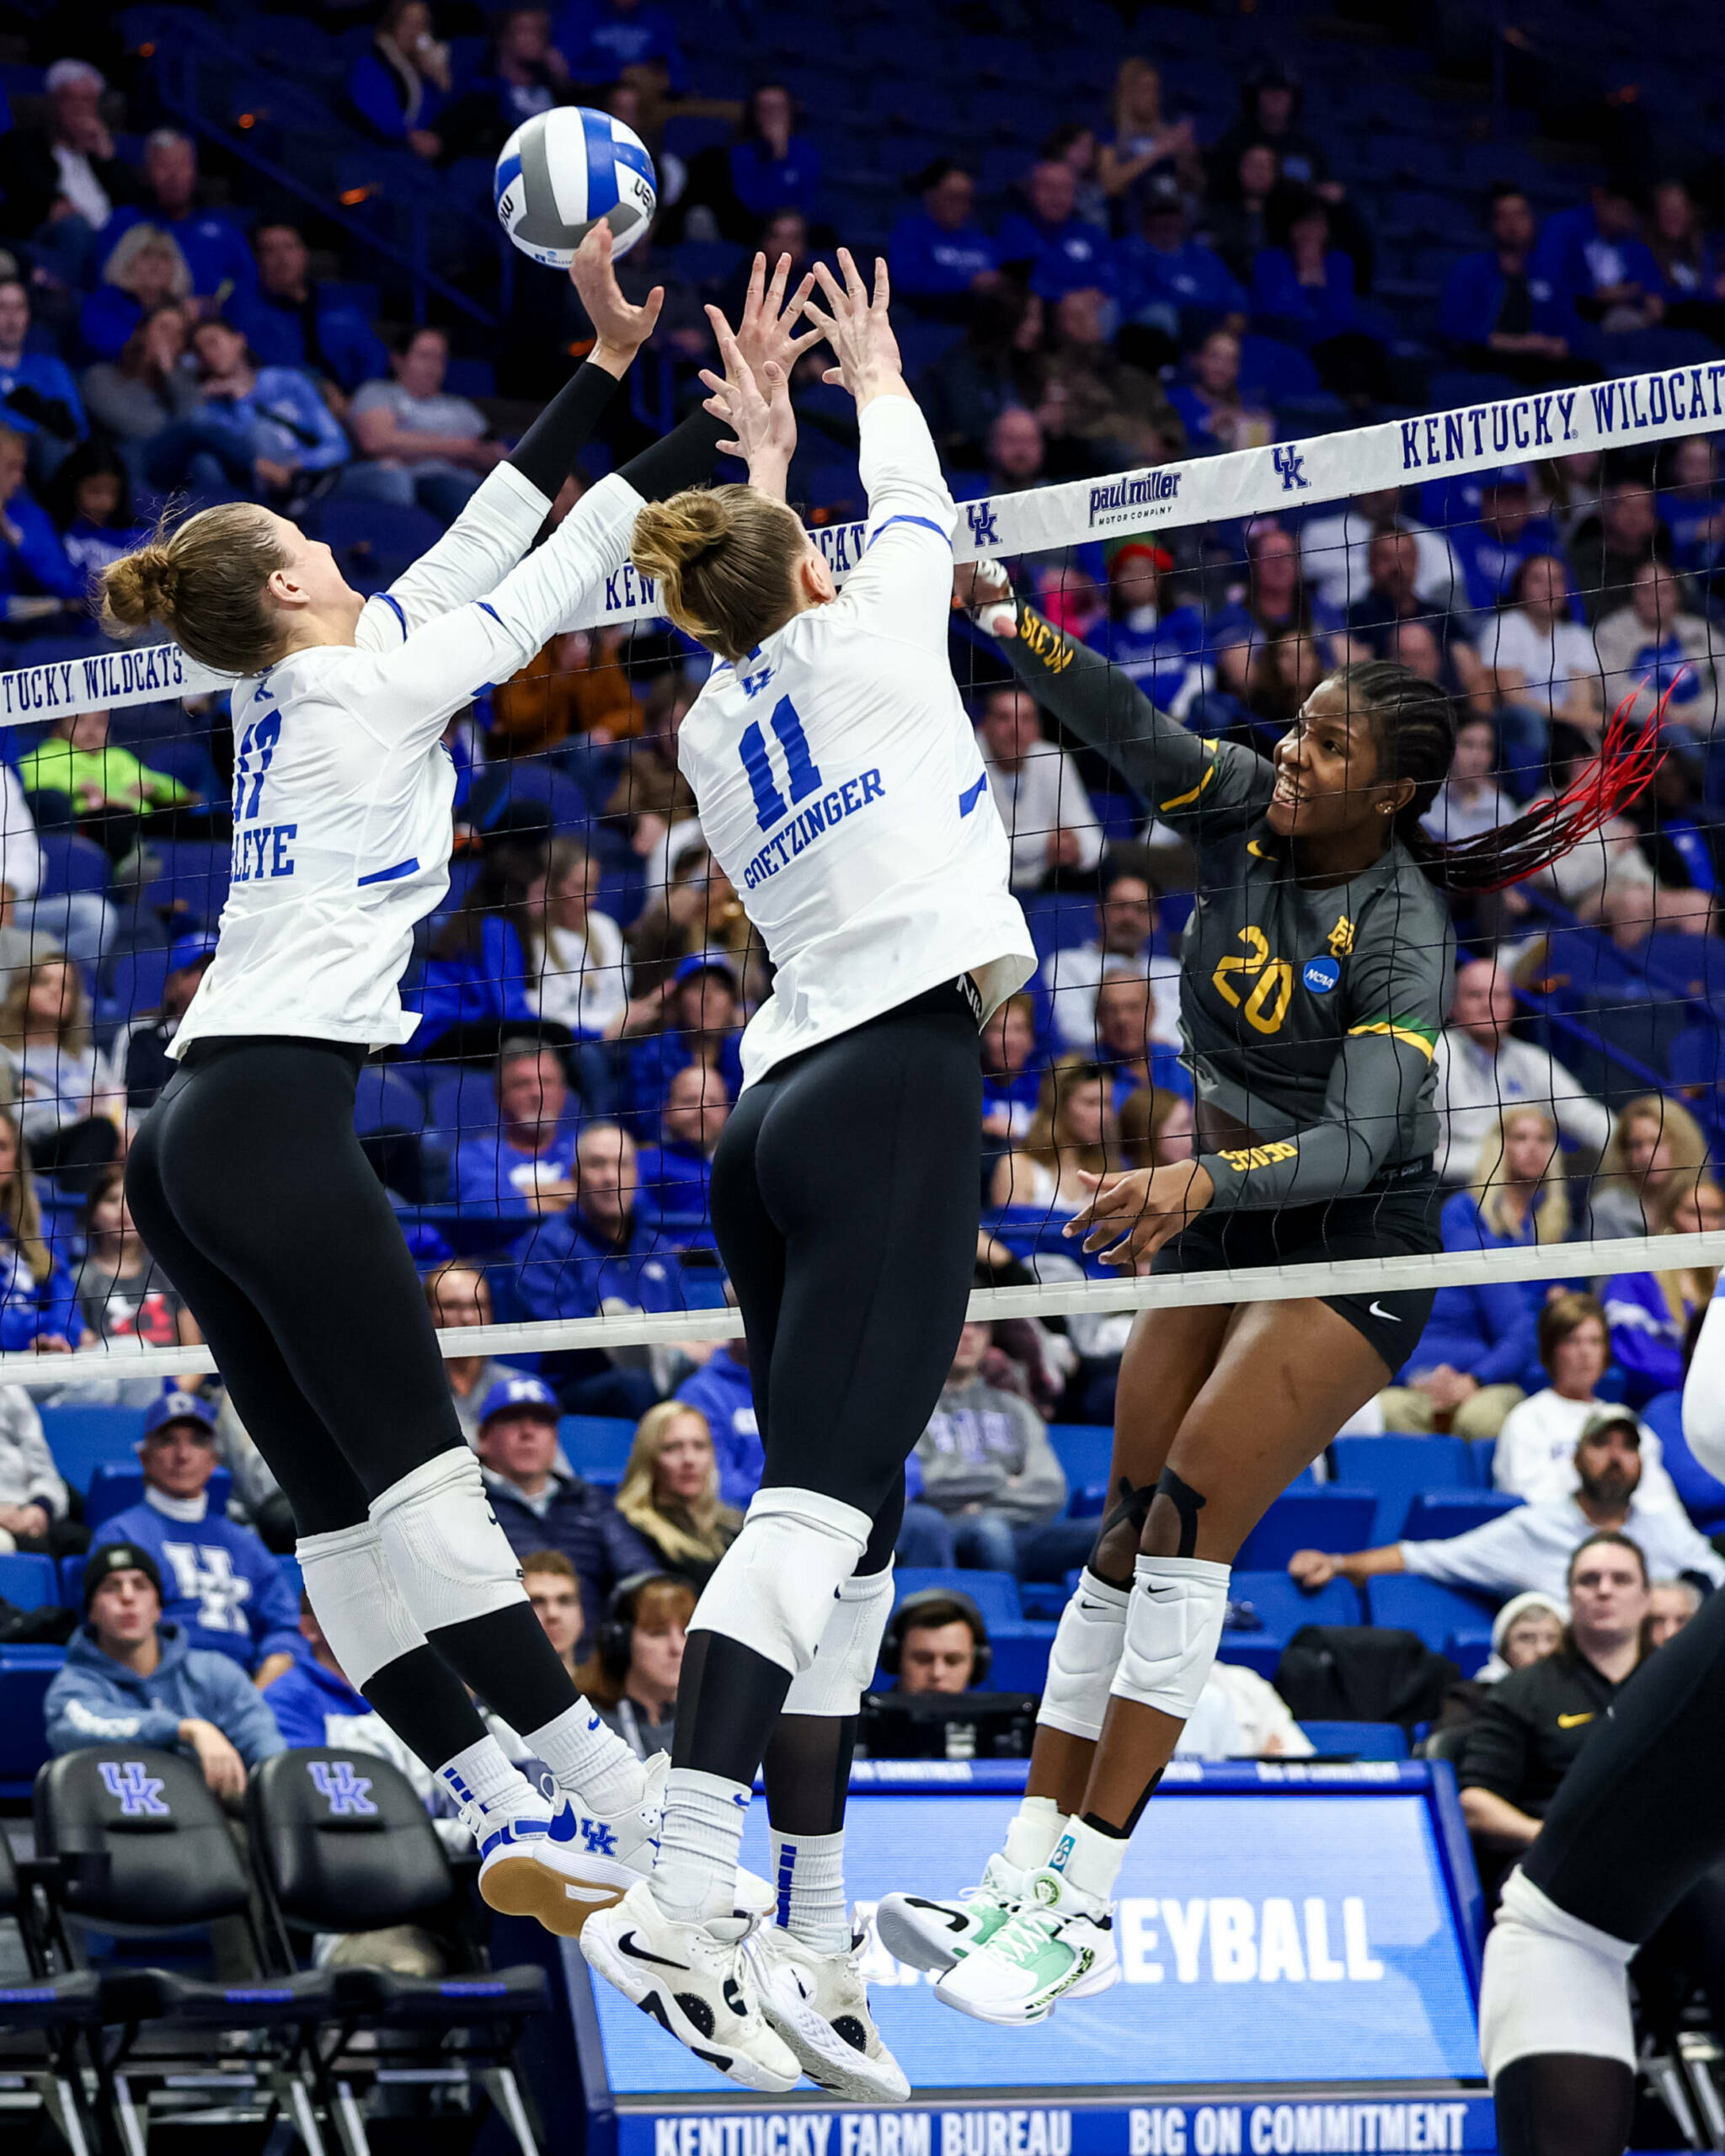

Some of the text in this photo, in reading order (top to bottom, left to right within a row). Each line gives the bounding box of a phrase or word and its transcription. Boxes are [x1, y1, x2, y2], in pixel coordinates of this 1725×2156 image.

[1401, 366, 1725, 469] KENTUCKY WILDCAT
[1273, 445, 1308, 491] UK
[967, 502, 1001, 547] UK
[1098, 512, 1128, 526] MOTOR
[3, 646, 183, 713] TUCKY WILDCATS
[739, 693, 823, 832] 11
[230, 823, 297, 883] LEYE
[743, 767, 886, 889] GOETZINGER
[1211, 925, 1293, 1034] 20
[1306, 969, 1335, 989] NCAA
[98, 1761, 170, 1816] UK
[307, 1761, 379, 1816] UK
[580, 1817, 619, 1857] UK
[1120, 1897, 1384, 1983] EYBALL
[654, 2111, 1072, 2156] KENTUCKY FARM BUREAU
[1129, 2103, 1468, 2156] BIG ON COMMITMENT
